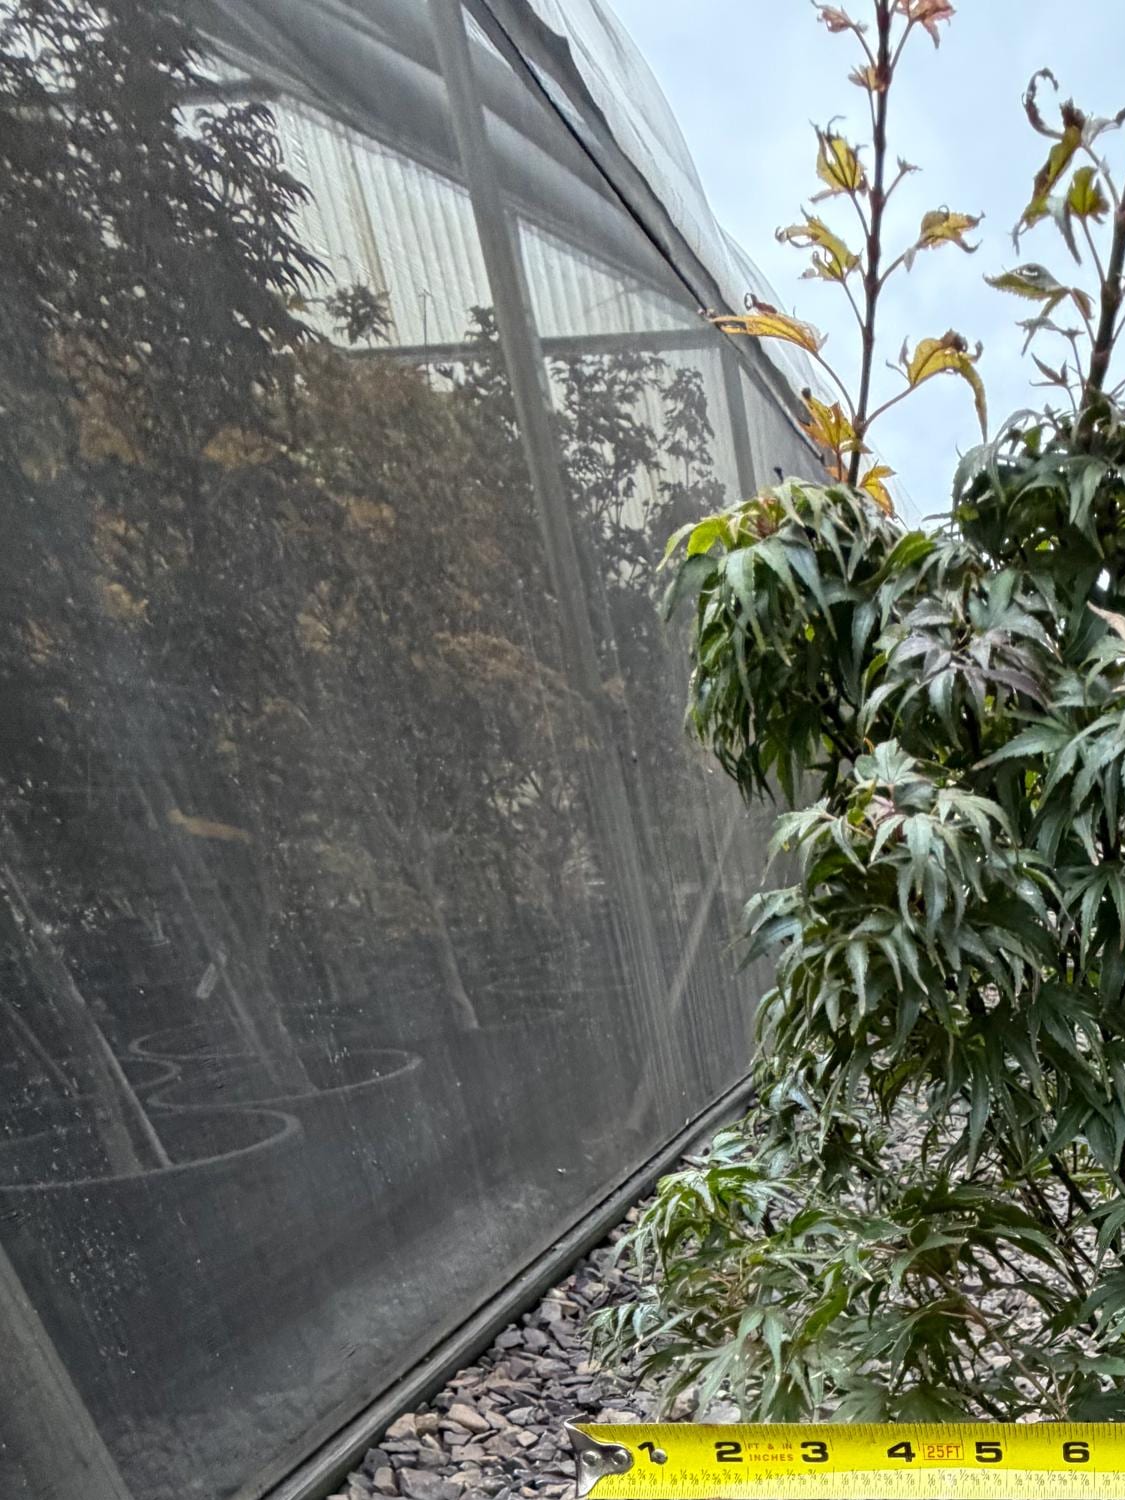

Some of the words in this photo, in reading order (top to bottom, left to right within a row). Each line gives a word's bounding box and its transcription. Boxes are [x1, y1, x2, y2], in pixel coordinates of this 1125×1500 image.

[637, 1441, 657, 1463] 1
[714, 1441, 743, 1463] 2
[800, 1440, 829, 1463] 3
[886, 1441, 917, 1463] 4
[974, 1441, 1004, 1463] 5
[1062, 1441, 1090, 1463] 6
[749, 1453, 794, 1462] INCHES
[927, 1445, 961, 1458] 25FT
